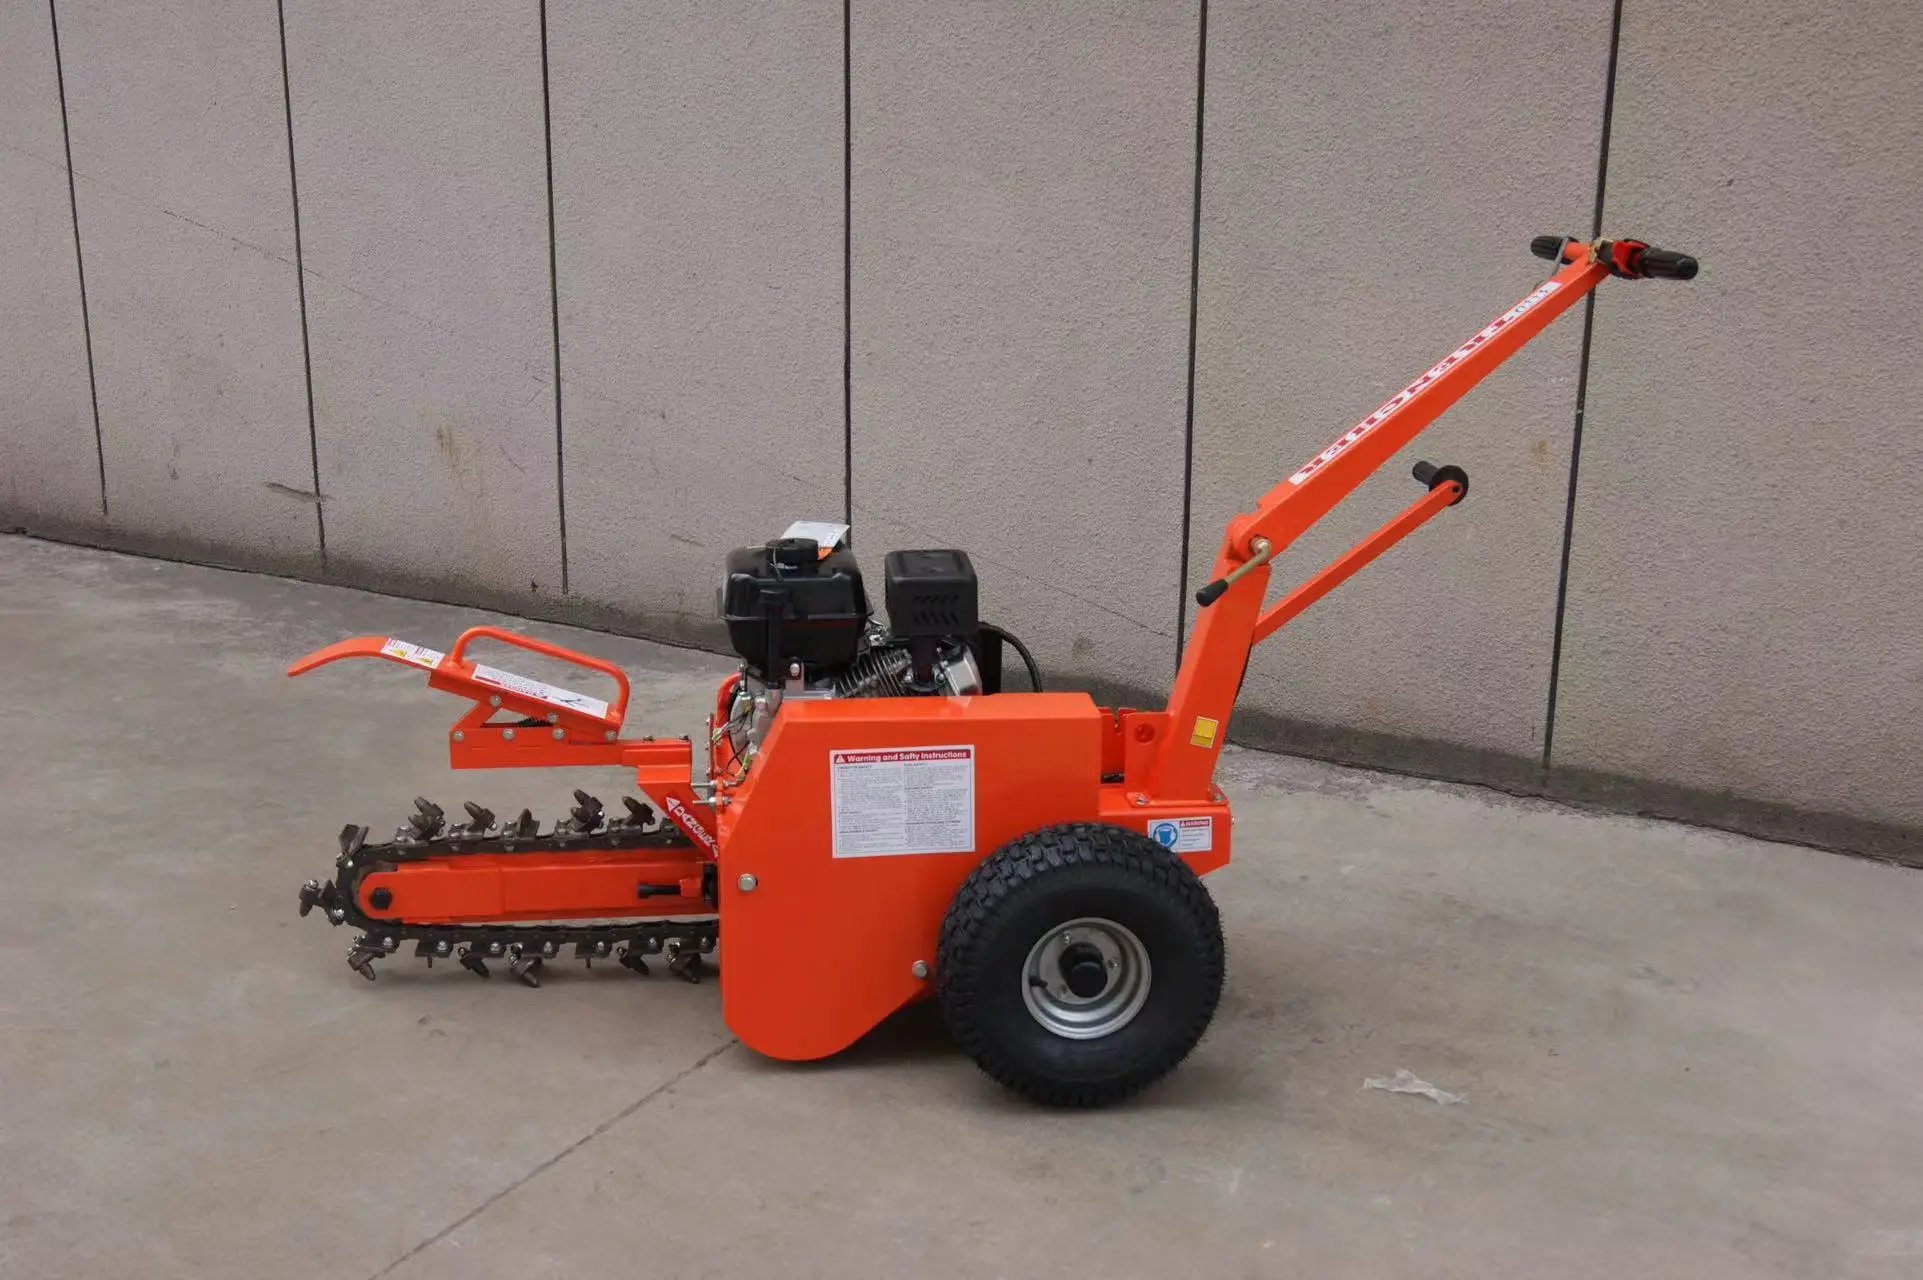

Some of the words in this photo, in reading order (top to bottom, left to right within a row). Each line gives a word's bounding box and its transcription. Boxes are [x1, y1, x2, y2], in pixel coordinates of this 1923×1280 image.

[1298, 314, 1511, 475] TRENCHER
[847, 754, 881, 763] Warning
[882, 753, 898, 761] and
[899, 752, 920, 761] Safty
[921, 751, 966, 759] Instructions
